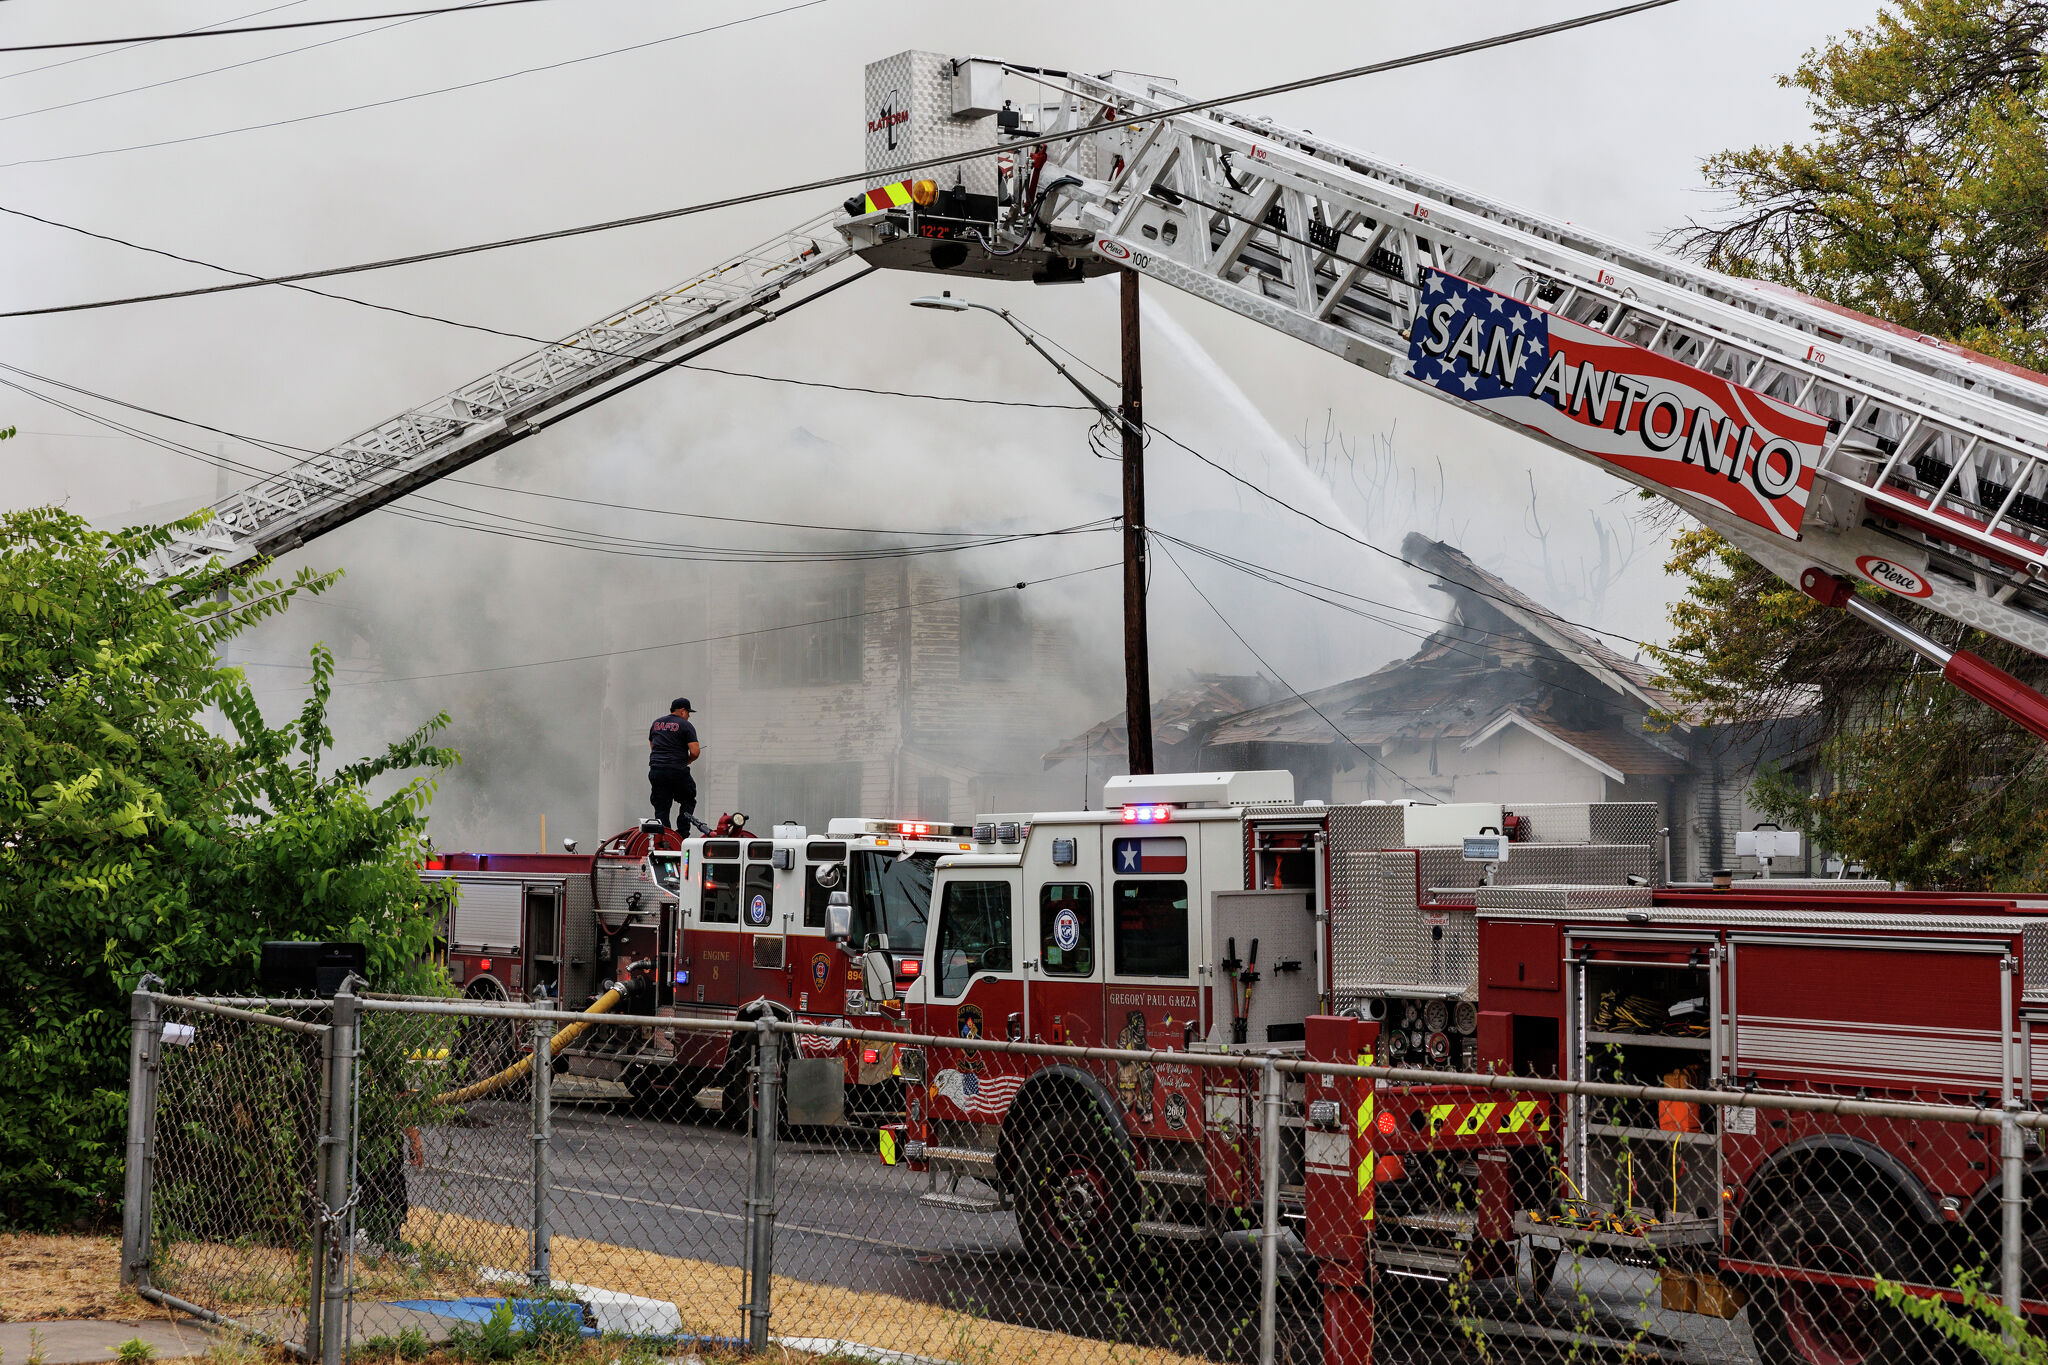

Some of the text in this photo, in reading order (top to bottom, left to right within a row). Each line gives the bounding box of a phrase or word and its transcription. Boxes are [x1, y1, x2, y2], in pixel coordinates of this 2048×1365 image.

[868, 110, 909, 133] PLATFORM
[880, 89, 897, 151] 1
[1256, 149, 1267, 160] 100
[1419, 208, 1429, 218] 90
[1104, 241, 1123, 255] Pierce
[1604, 275, 1615, 286] 80
[1814, 351, 1826, 363] 70
[1422, 303, 1802, 500] SAN ANTONIO
[1870, 561, 1916, 590] Pierce
[653, 721, 680, 732] SAFD
[703, 950, 730, 961] ENGINE
[712, 965, 719, 980] 8
[1110, 993, 1197, 1008] GREGORY PAUL GARZA
